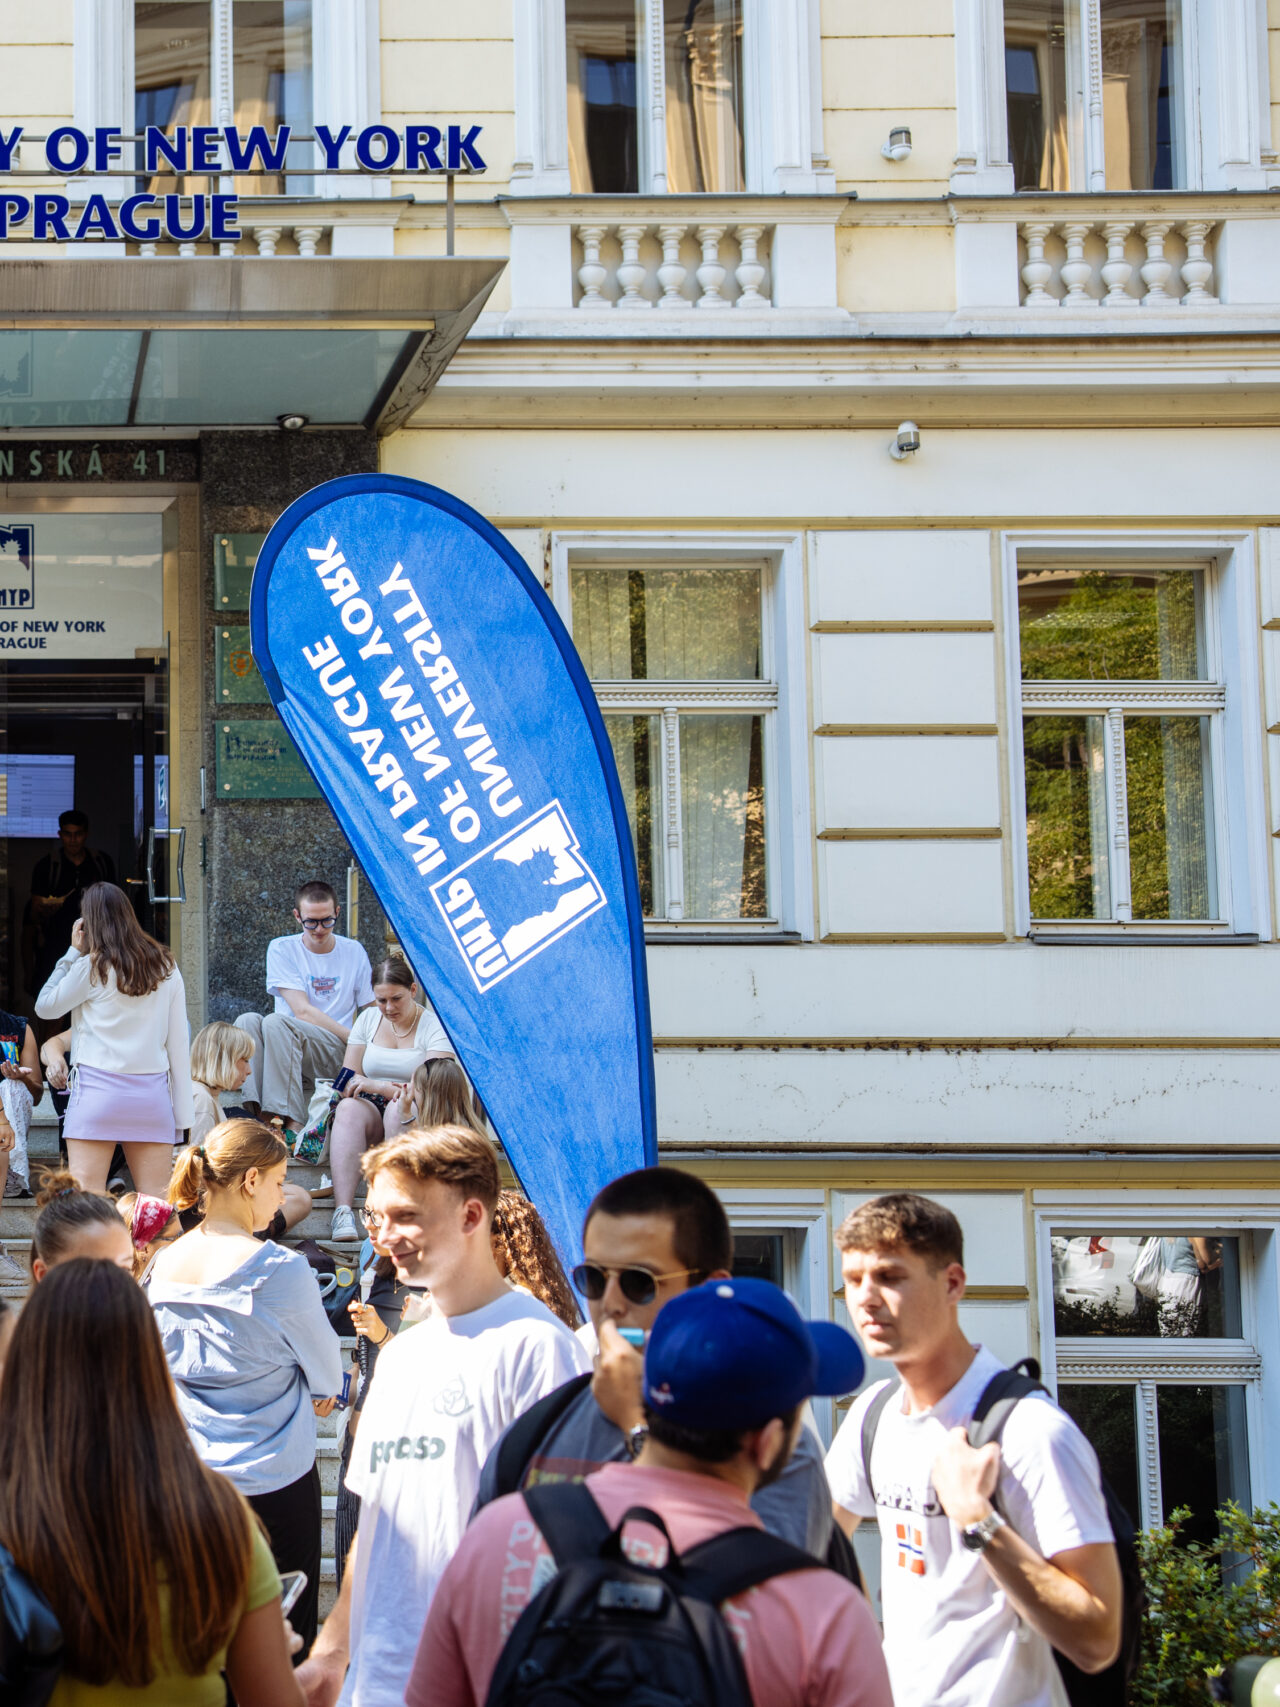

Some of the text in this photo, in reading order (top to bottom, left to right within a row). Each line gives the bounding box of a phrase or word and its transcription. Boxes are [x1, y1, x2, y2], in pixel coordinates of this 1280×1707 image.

[44, 125, 124, 174] OF
[145, 125, 292, 173] NEW
[312, 124, 489, 172] YORK
[132, 449, 167, 476] 41
[0, 620, 18, 633] OF
[23, 621, 59, 633] NEW
[64, 620, 106, 633] YORK
